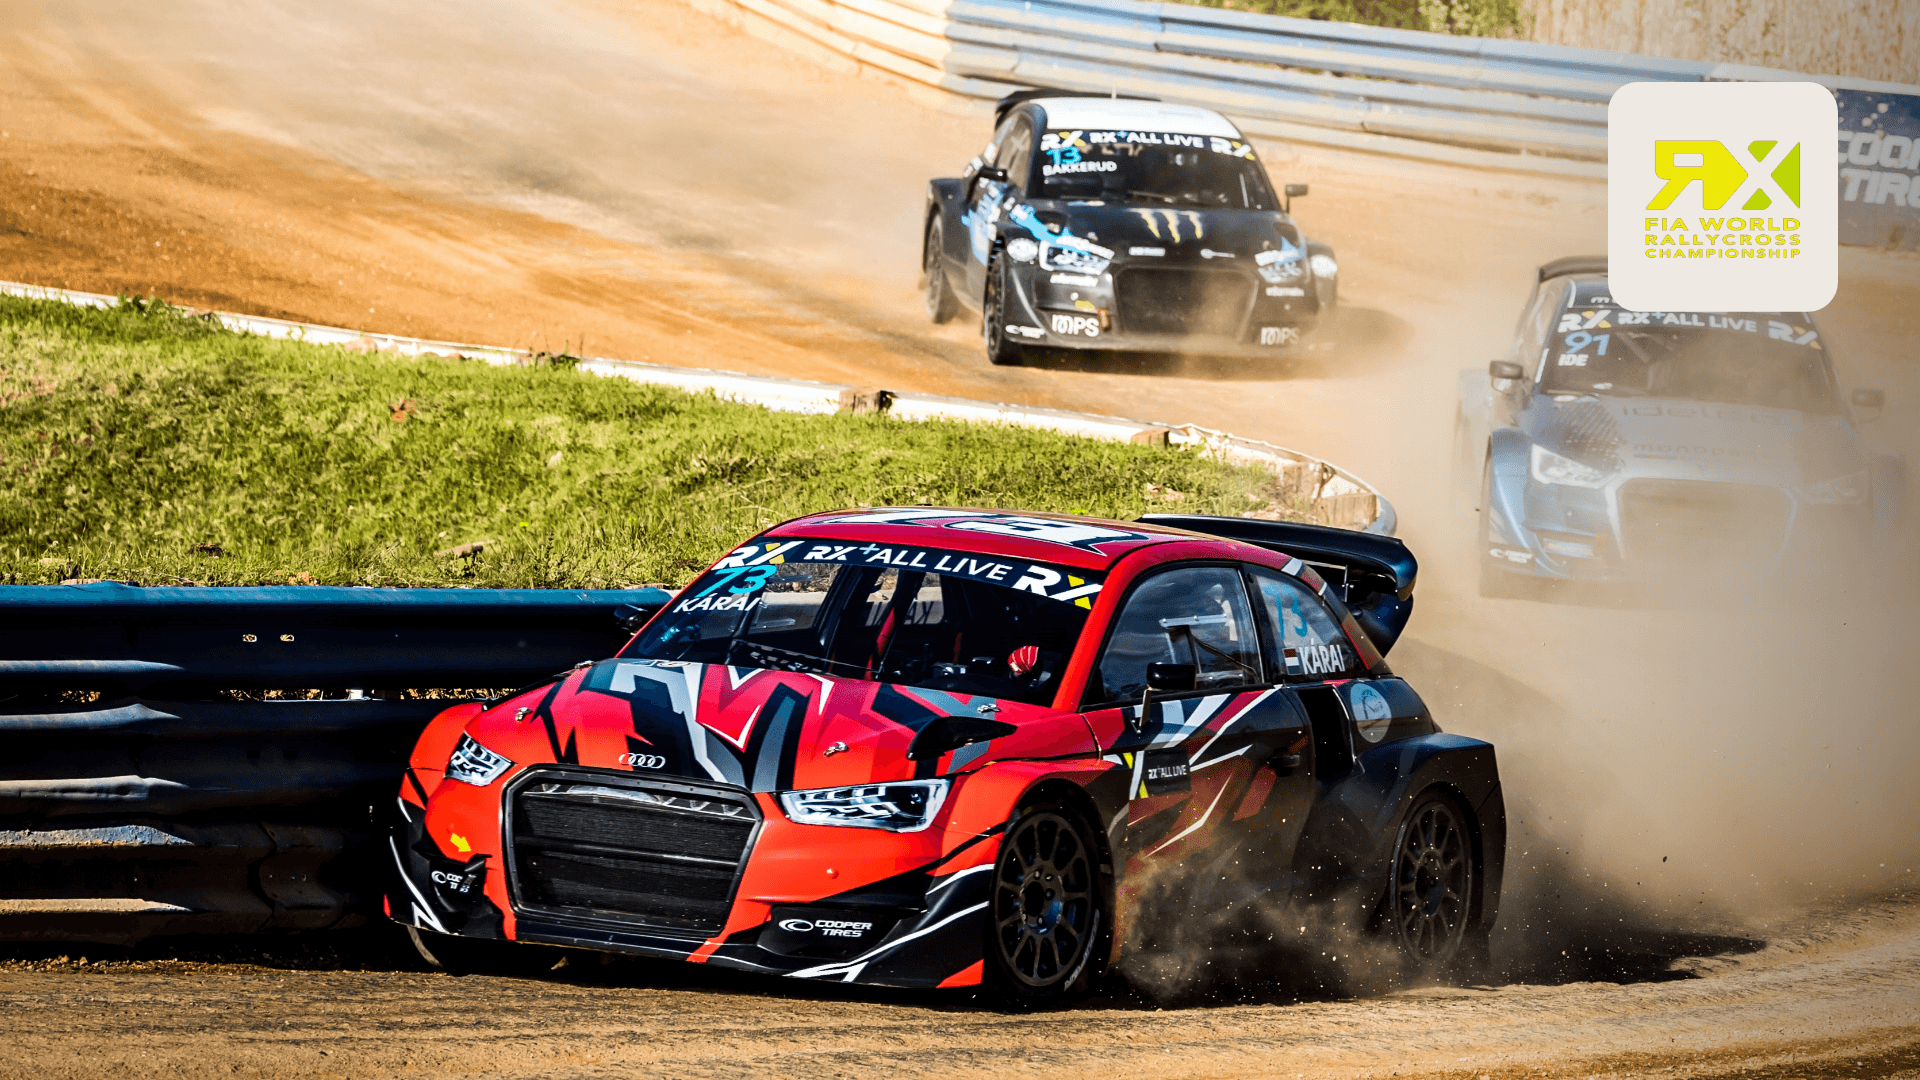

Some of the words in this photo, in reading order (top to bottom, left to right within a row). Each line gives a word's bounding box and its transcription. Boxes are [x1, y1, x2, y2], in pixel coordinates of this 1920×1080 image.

[1163, 133, 1204, 149] LIVE
[1046, 146, 1082, 165] 13
[1042, 160, 1118, 177] BAKKERUD
[1709, 315, 1758, 333] LIVE
[1565, 331, 1611, 357] 91
[1557, 353, 1590, 367] IDE
[933, 558, 1014, 582] LIVE
[694, 565, 778, 598] 73
[672, 593, 762, 613] KÁRAI
[1262, 584, 1308, 640] 73
[1298, 637, 1346, 675] KÁRAI
[814, 920, 873, 931] COOPER
[821, 928, 863, 938] TIRES
